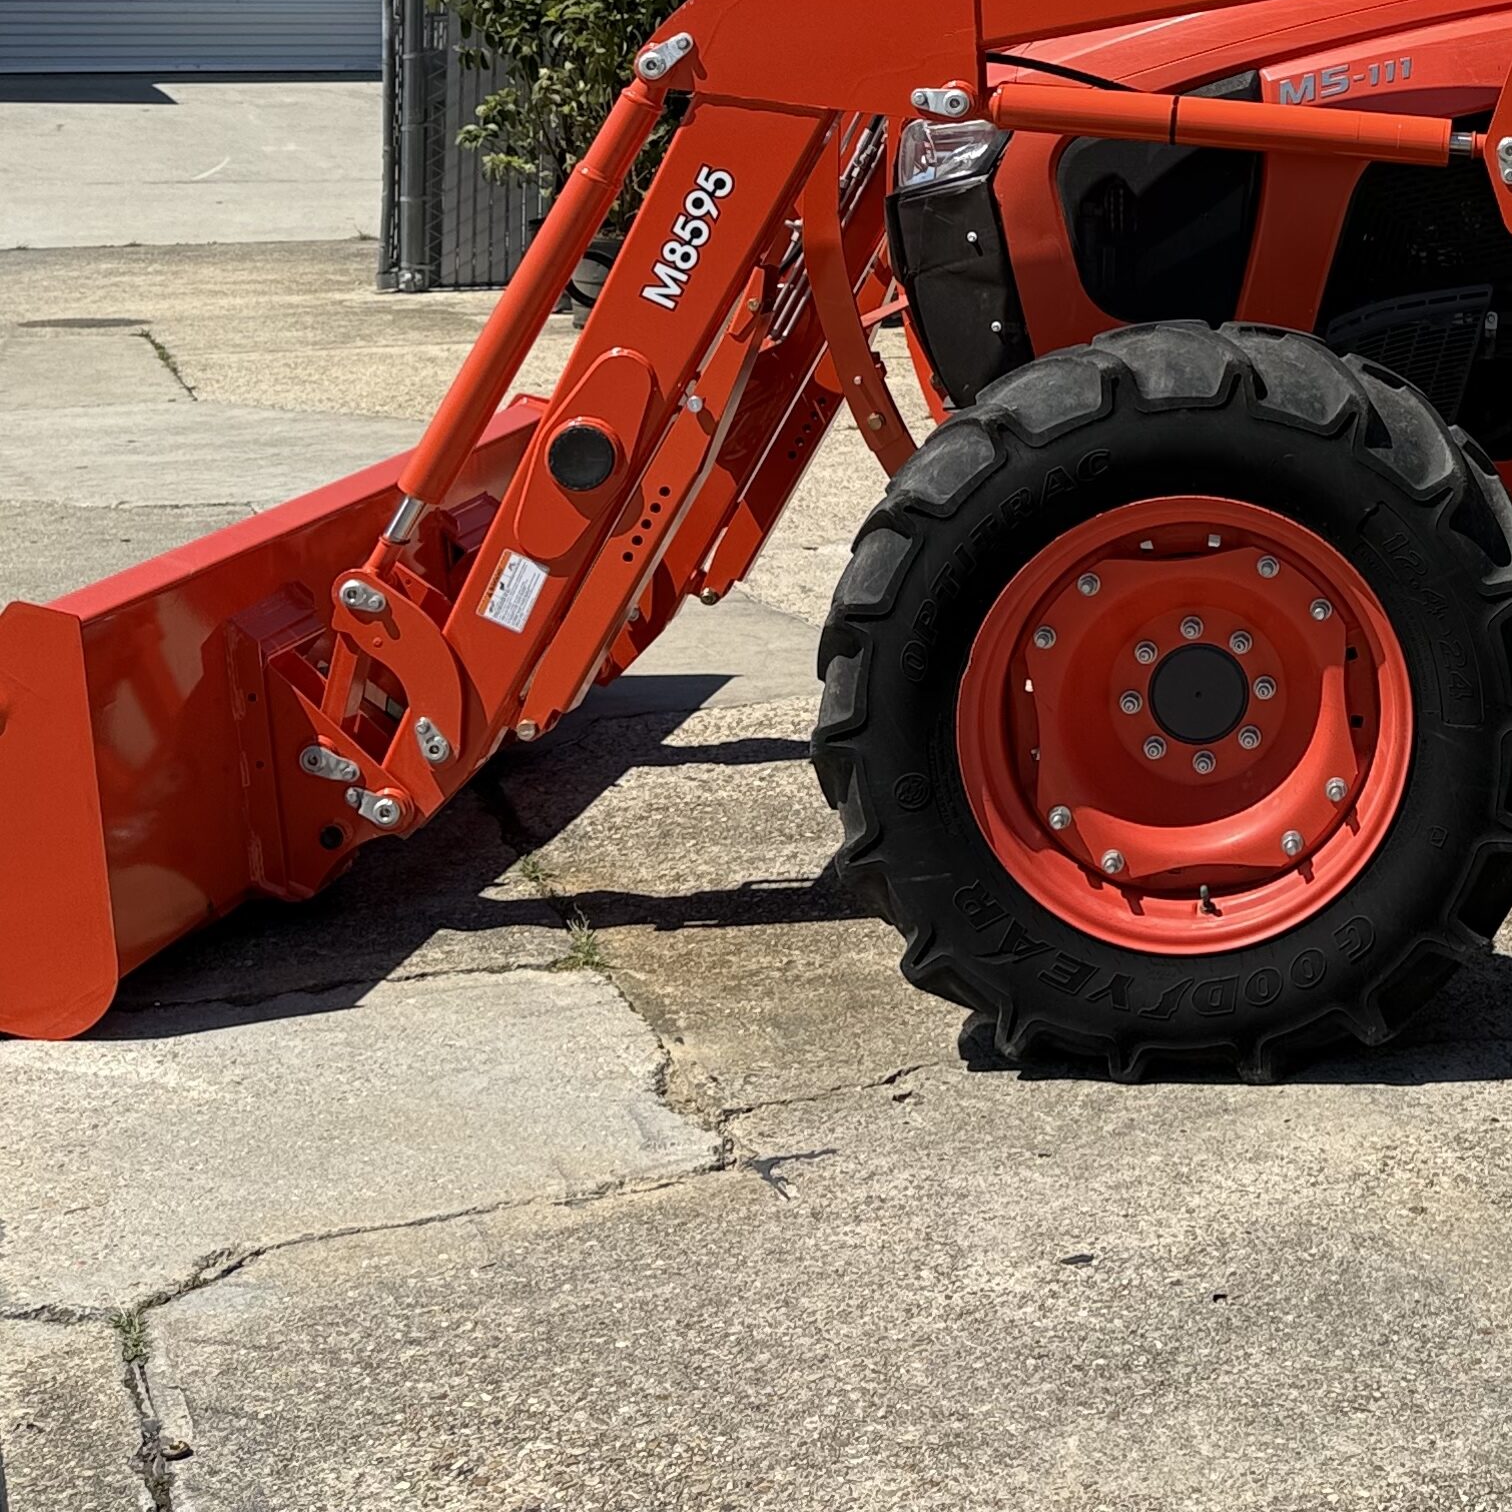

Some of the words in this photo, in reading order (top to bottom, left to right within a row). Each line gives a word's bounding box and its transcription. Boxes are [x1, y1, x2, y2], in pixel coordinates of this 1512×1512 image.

[1278, 56, 1413, 105] M5-111
[640, 165, 735, 311] M8595
[900, 448, 1111, 683] OPTITRAC
[952, 879, 1377, 1019] GOODYEAR
